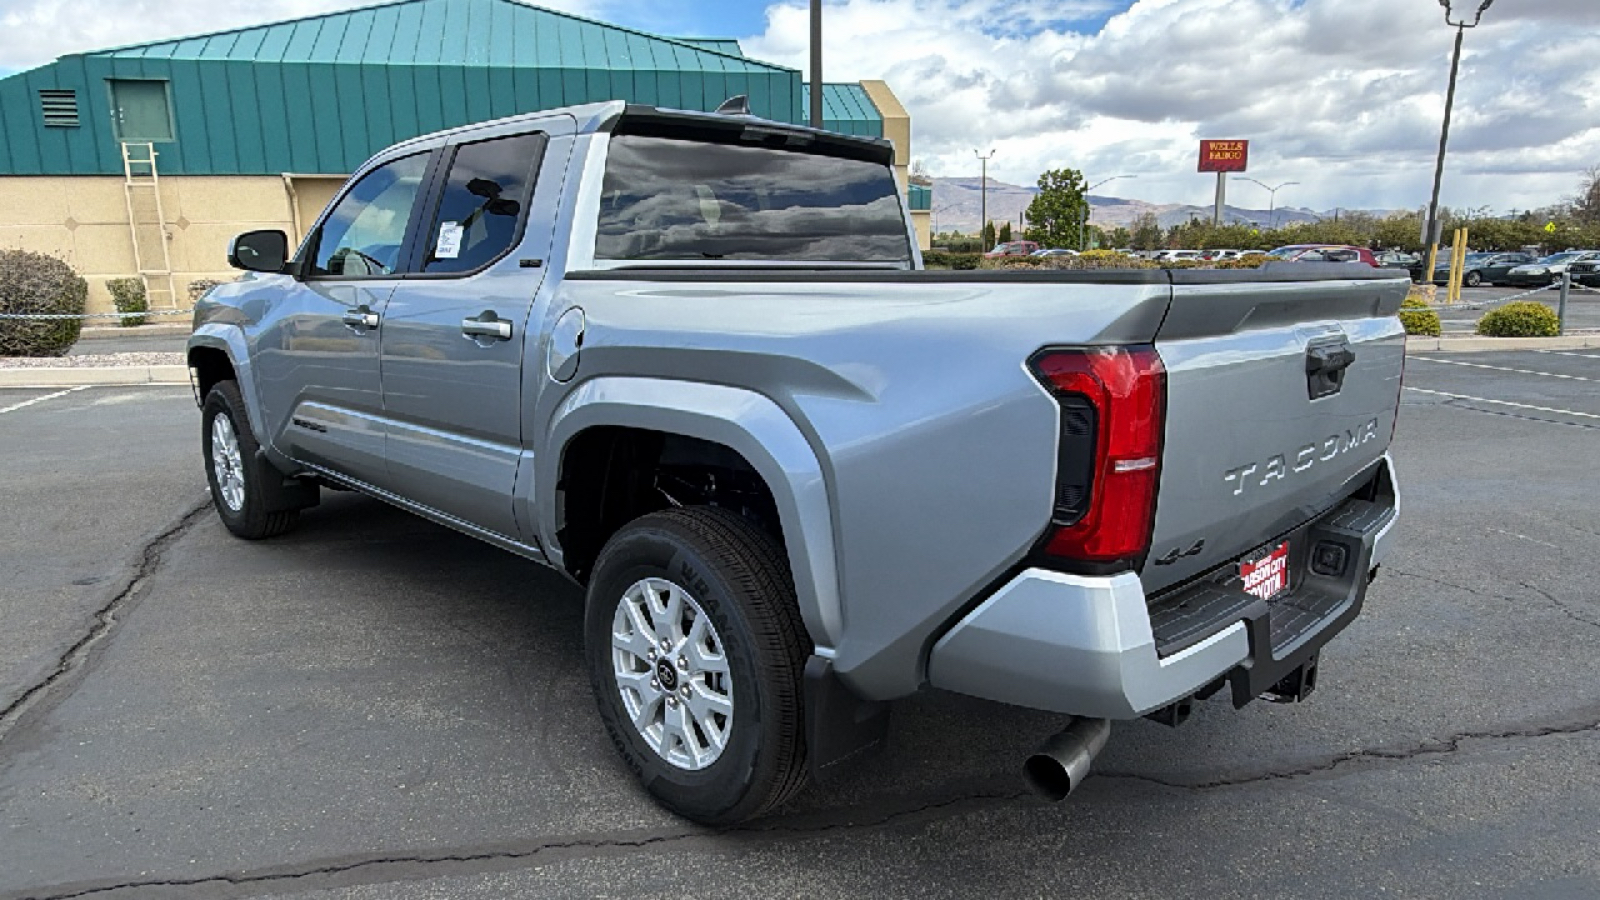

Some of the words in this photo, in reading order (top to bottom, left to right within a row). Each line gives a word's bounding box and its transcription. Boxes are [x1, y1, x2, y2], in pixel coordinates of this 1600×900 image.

[1209, 142, 1243, 150] WELLS
[1209, 151, 1242, 160] FARGO
[1224, 417, 1378, 496] TACOMA
[1241, 562, 1271, 590] ARSON
[1271, 555, 1287, 575] CITY
